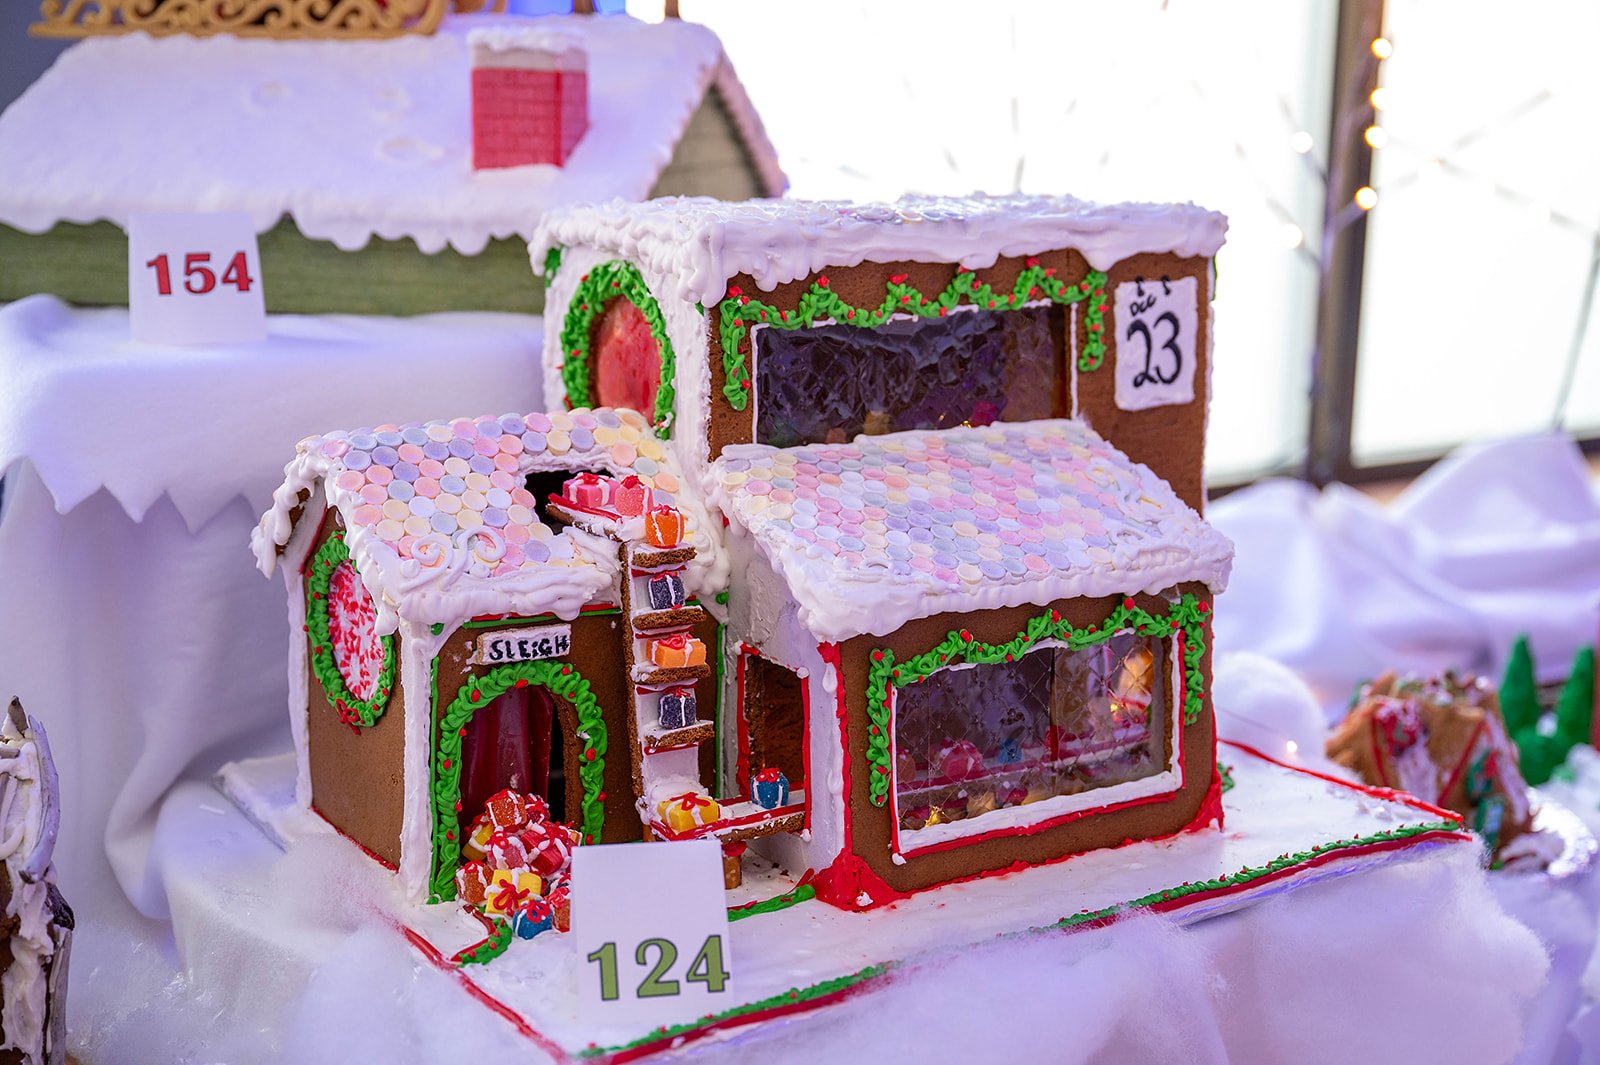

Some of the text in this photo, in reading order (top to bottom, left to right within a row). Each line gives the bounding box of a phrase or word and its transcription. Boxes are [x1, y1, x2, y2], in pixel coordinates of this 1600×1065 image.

[146, 250, 254, 296] 154
[1126, 311, 1183, 388] 23
[587, 934, 731, 1002] 124
